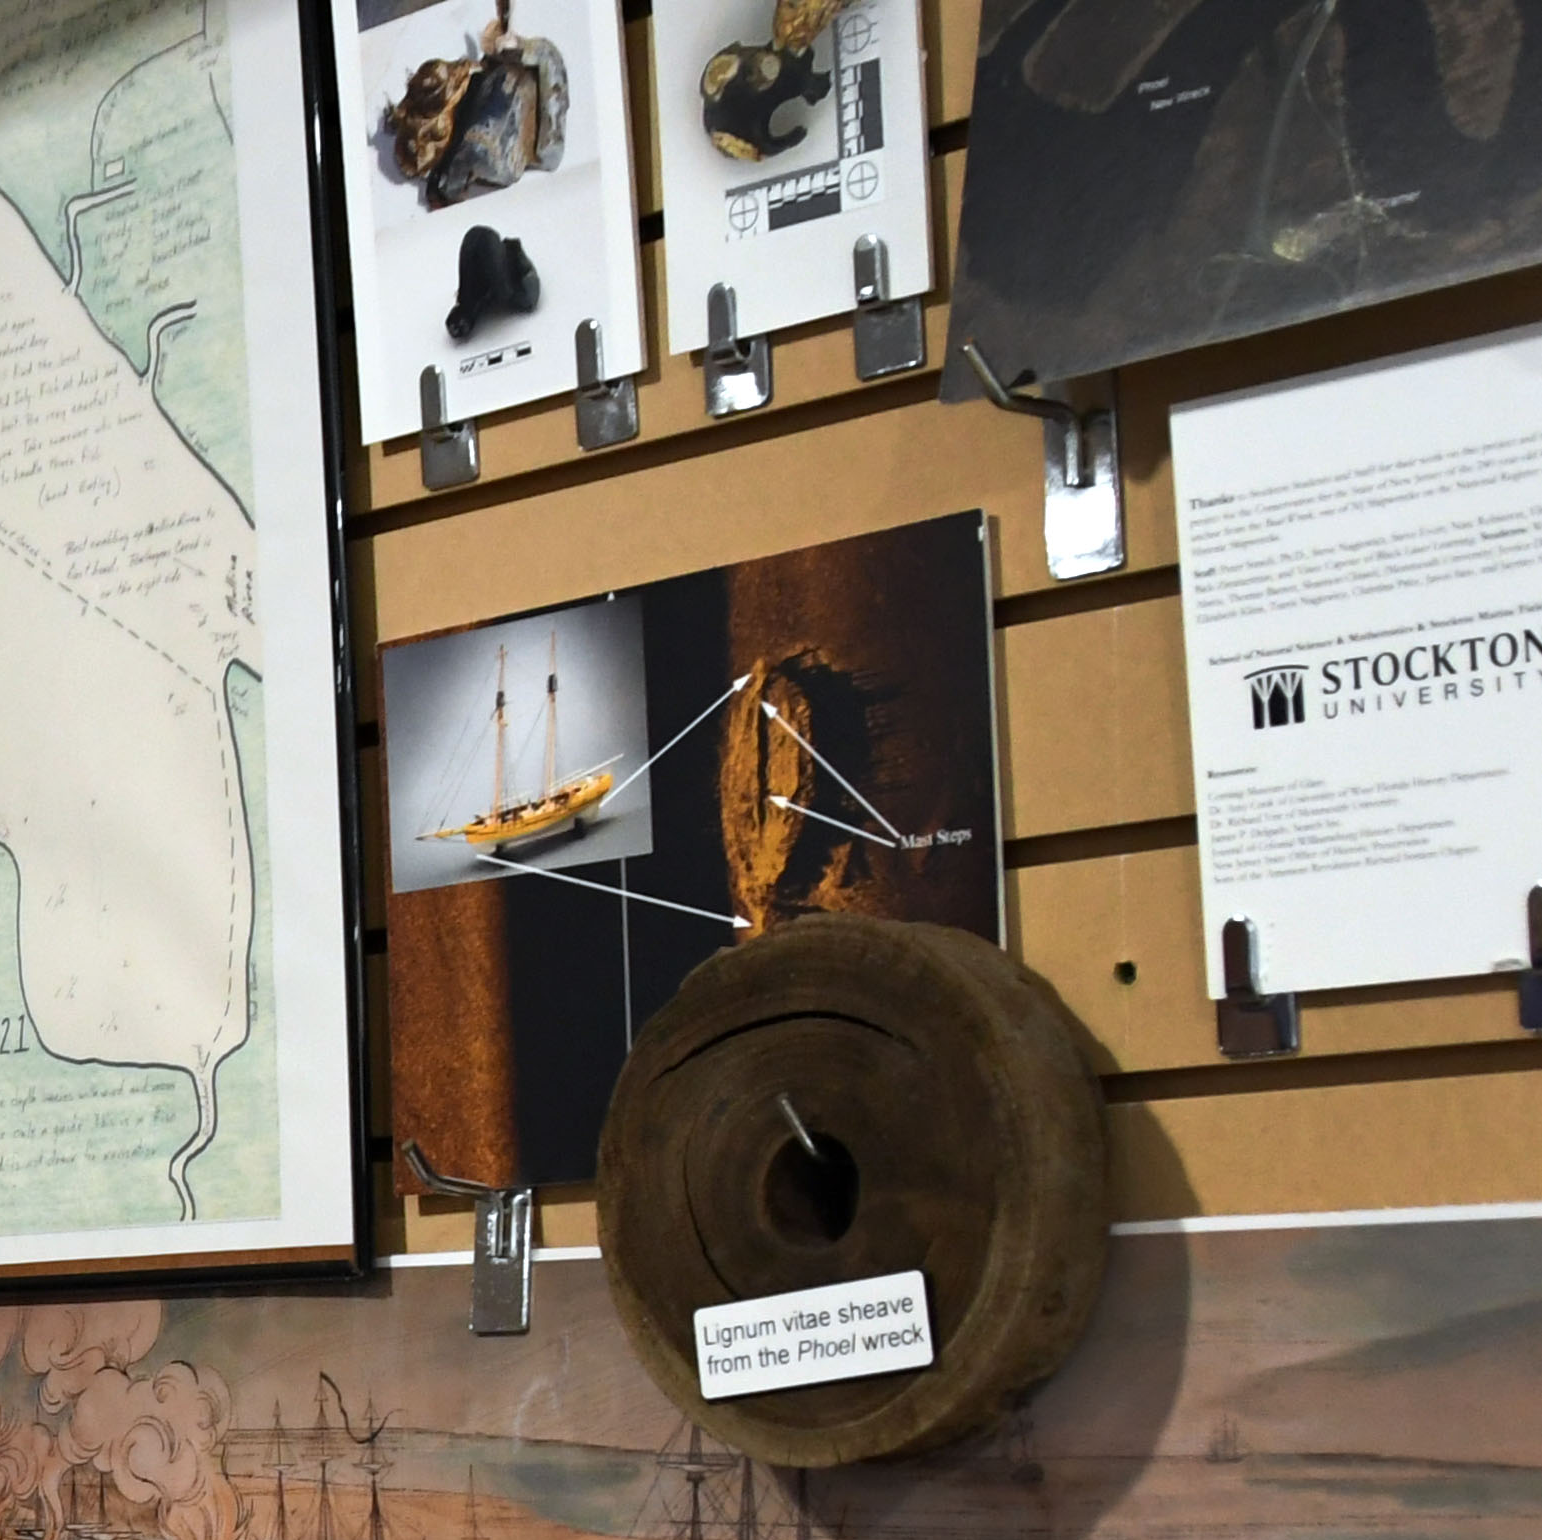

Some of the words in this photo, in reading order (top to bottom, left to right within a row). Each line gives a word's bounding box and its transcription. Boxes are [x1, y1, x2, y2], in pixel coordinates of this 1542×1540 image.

[936, 828, 973, 846] Steps
[704, 1318, 777, 1349] Lignum
[782, 1309, 831, 1333] vitae
[838, 1296, 914, 1325] sheave
[707, 1353, 753, 1376] from
[758, 1346, 791, 1369] the
[797, 1333, 857, 1362] Phoel
[862, 1323, 925, 1352] wreck
